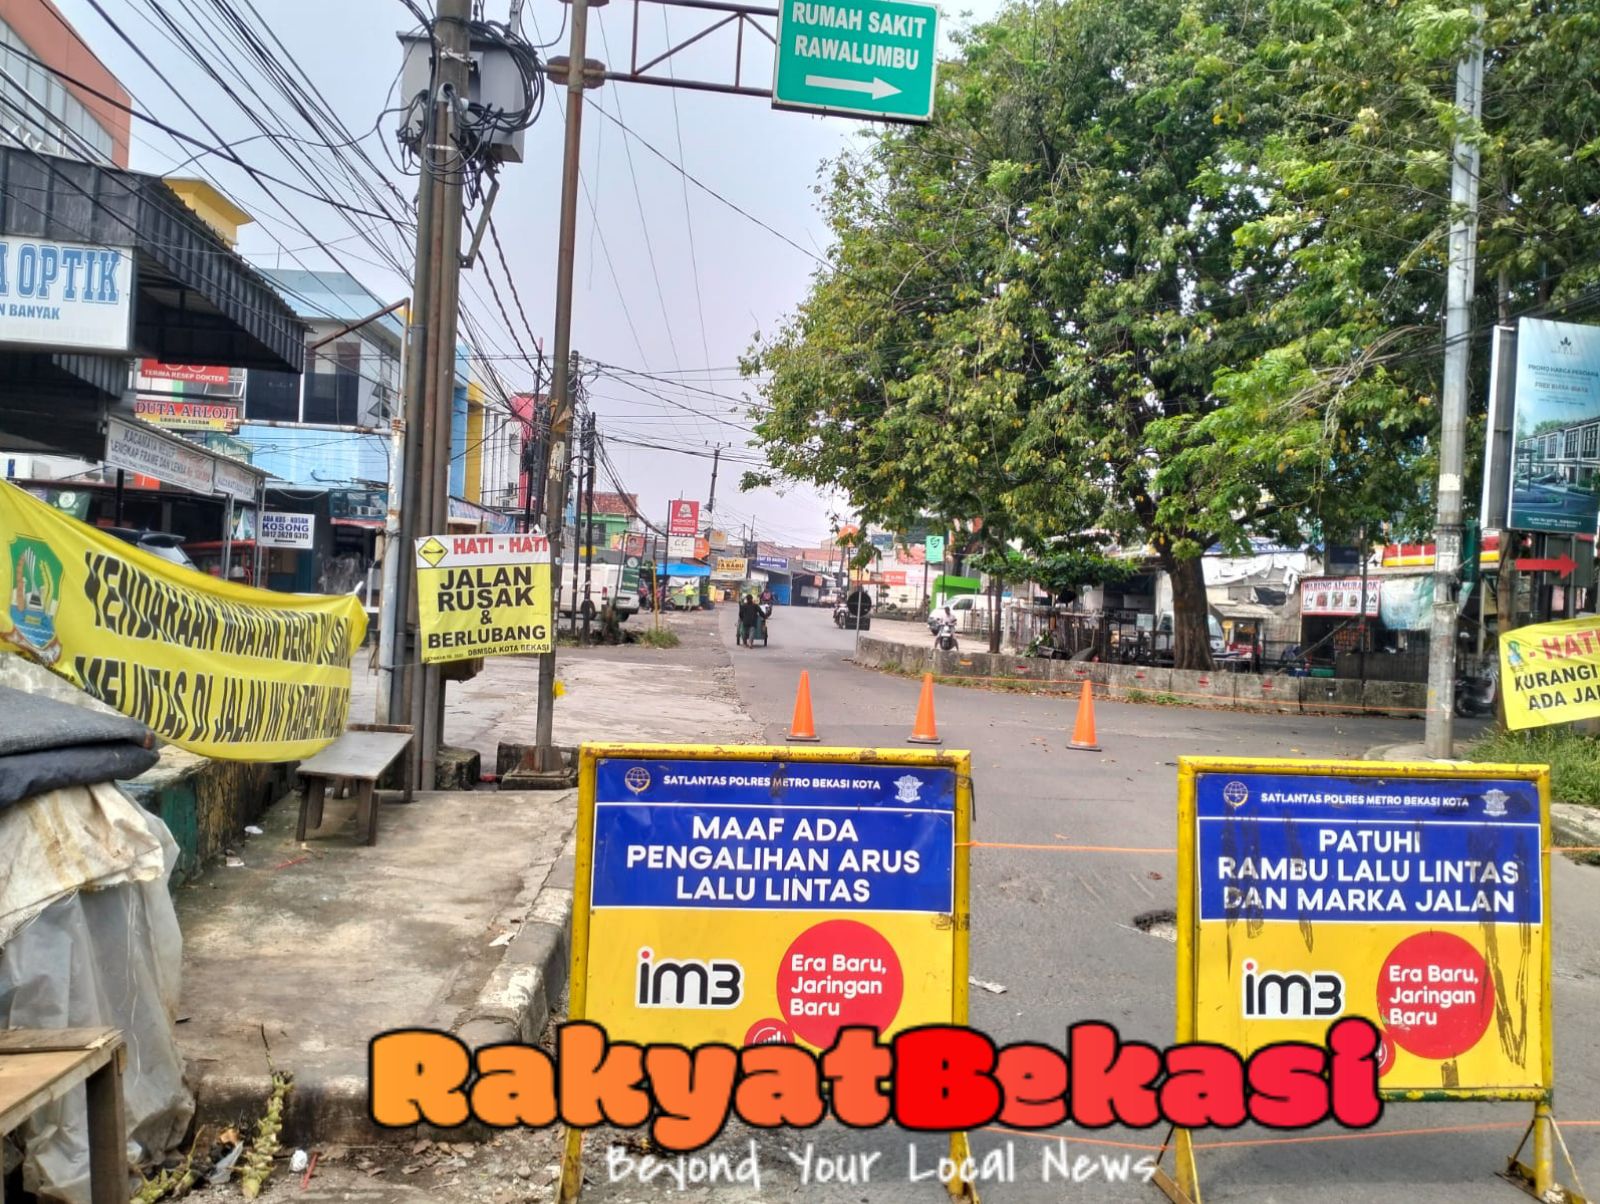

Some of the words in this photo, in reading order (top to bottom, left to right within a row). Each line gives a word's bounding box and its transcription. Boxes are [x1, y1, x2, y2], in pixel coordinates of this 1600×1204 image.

[792, 1, 863, 31] RUMAH
[868, 11, 928, 39] SAKIT
[794, 34, 920, 71] RAWALUMBU
[17, 243, 121, 305] OPTIK
[9, 304, 60, 320] BANYAK
[144, 369, 171, 377] TERIMA
[171, 371, 195, 379] RESEP
[195, 374, 225, 382] DOKTER
[136, 401, 176, 416] DUTA
[181, 404, 239, 419] ARLOJI
[262, 522, 310, 533] KOSONG
[453, 538, 494, 555] HATI
[509, 536, 549, 553] HATI
[440, 566, 533, 591] JALAN
[1304, 581, 1332, 591] WARUNG
[438, 586, 537, 612] RUSAK
[480, 609, 493, 626] &
[272, 608, 319, 667] BERAT
[428, 625, 547, 649] BERLUBANG
[499, 644, 520, 653] KOTA
[520, 643, 551, 652] BEKASI
[1515, 663, 1598, 692] KURANGI
[188, 672, 214, 742] DI
[212, 675, 267, 743] JALAN
[262, 681, 287, 743] INI
[1529, 691, 1567, 711] ADA
[663, 775, 727, 786] SATLANTAS
[729, 776, 771, 787] POLRES
[772, 777, 810, 788] METRO
[812, 778, 850, 789] BEKASI
[852, 779, 881, 790] KOTA
[1261, 792, 1322, 804] SATLANTAS
[1324, 794, 1364, 805] POLRES
[1366, 795, 1402, 806] METRO
[1403, 796, 1440, 807] BEKASI
[1442, 797, 1470, 808] KOTA
[692, 815, 786, 841] MAAF
[792, 818, 859, 842] ADA
[1318, 828, 1421, 854] PATUHI
[626, 844, 830, 872] PENGALIHAN
[837, 848, 921, 873] ARUS
[1218, 855, 1329, 882] RAMBU
[1337, 858, 1411, 883] LALU
[1419, 859, 1519, 885] LINTAS
[676, 875, 756, 901] LALU
[764, 877, 871, 903] LINTAS
[1223, 886, 1288, 911] DAN
[1297, 887, 1407, 913] MARKA
[1414, 888, 1515, 914] JALAN
[638, 949, 742, 1005] im3
[791, 954, 827, 973] Era
[832, 954, 887, 976] Baru,
[1389, 964, 1425, 983] Era
[1427, 964, 1480, 986] Baru,
[790, 975, 883, 999] Jaringan
[1245, 960, 1342, 1016] im3
[1389, 986, 1477, 1009] Jaringan
[789, 998, 841, 1017] Baru
[1389, 1007, 1438, 1027] Baru
